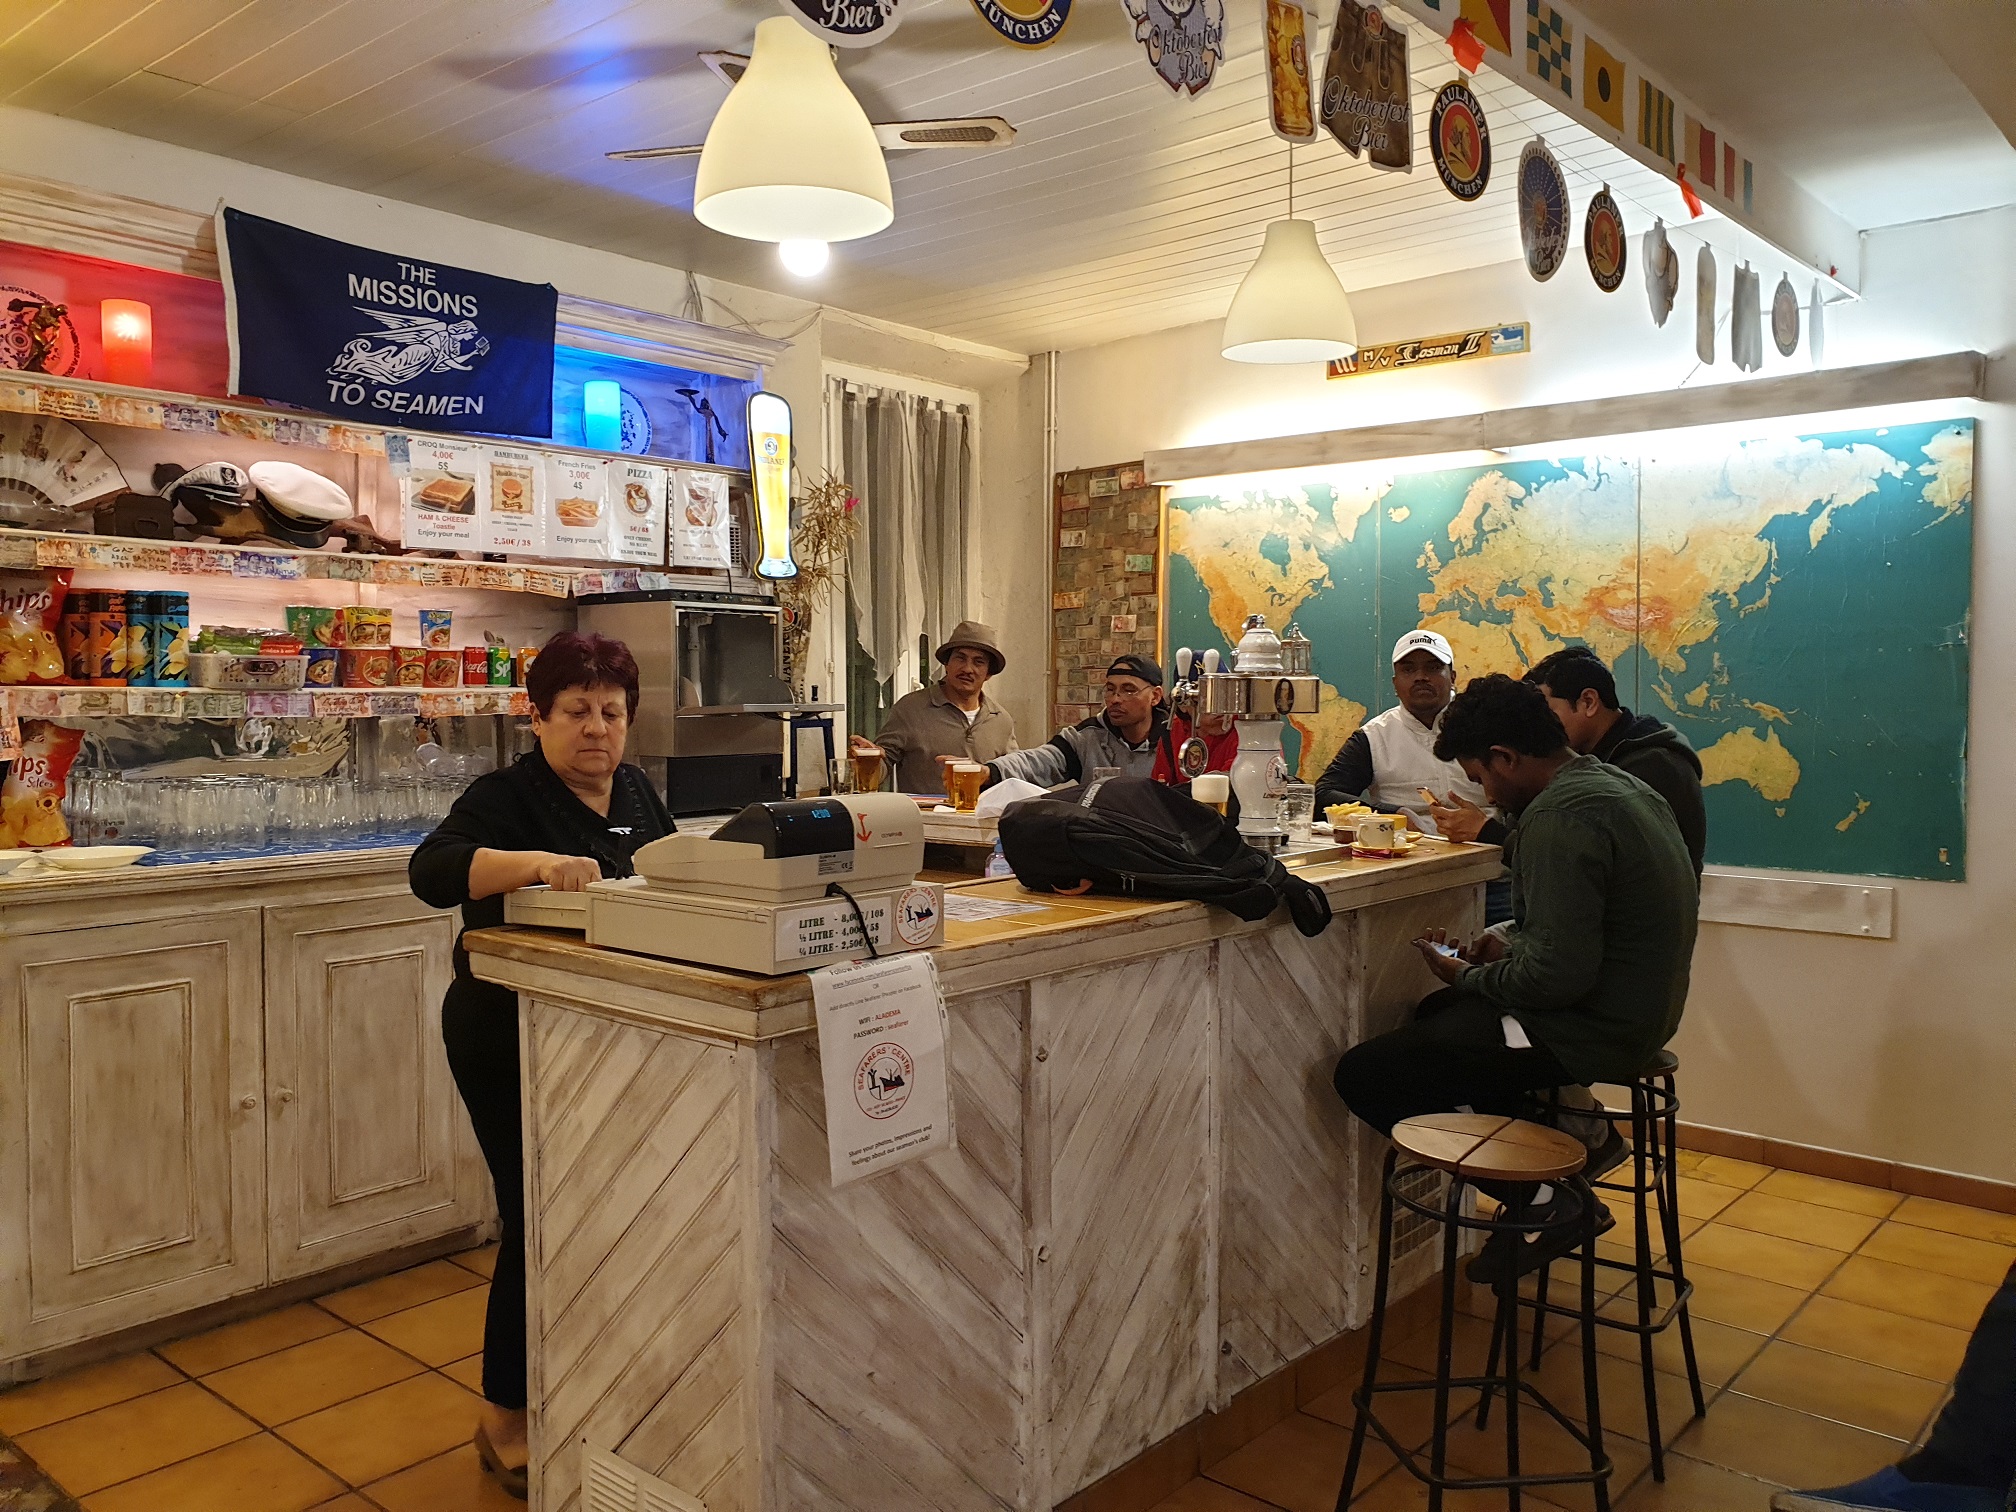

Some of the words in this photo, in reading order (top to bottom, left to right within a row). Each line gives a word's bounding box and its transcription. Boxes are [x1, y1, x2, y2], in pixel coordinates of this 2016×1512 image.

[819, 0, 878, 28] Bier
[1148, 24, 1222, 66] Oktoberfest
[1177, 51, 1208, 83] Bier
[1321, 75, 1411, 127] Oktoberfest
[1435, 86, 1487, 140] PAULANER
[1350, 116, 1389, 150] Bier
[397, 262, 437, 286] THE
[348, 273, 478, 318] MISSIONS
[326, 379, 366, 406] TO
[371, 389, 485, 416] SEAMEN
[417, 440, 438, 449] CROQ
[439, 443, 468, 452] Monsieur
[432, 451, 454, 460] 4,00€
[438, 462, 449, 471] 5$
[558, 460, 580, 469] French
[581, 462, 597, 471] Fries
[569, 470, 591, 480] 3,00€
[627, 468, 653, 480] PIZZA
[573, 481, 583, 490] 4$
[418, 514, 434, 522] HAM
[442, 515, 469, 524] CHEESE
[432, 523, 456, 531] Toastie
[418, 529, 437, 538] Enjoy
[438, 531, 453, 539] your
[557, 535, 574, 544] Enjoy
[799, 917, 825, 929] LITRE
[809, 929, 834, 942] LITRE
[809, 943, 834, 955] LITRE
[853, 1026, 884, 1039] PASSWORD
[891, 1048, 911, 1076] CENTRE
